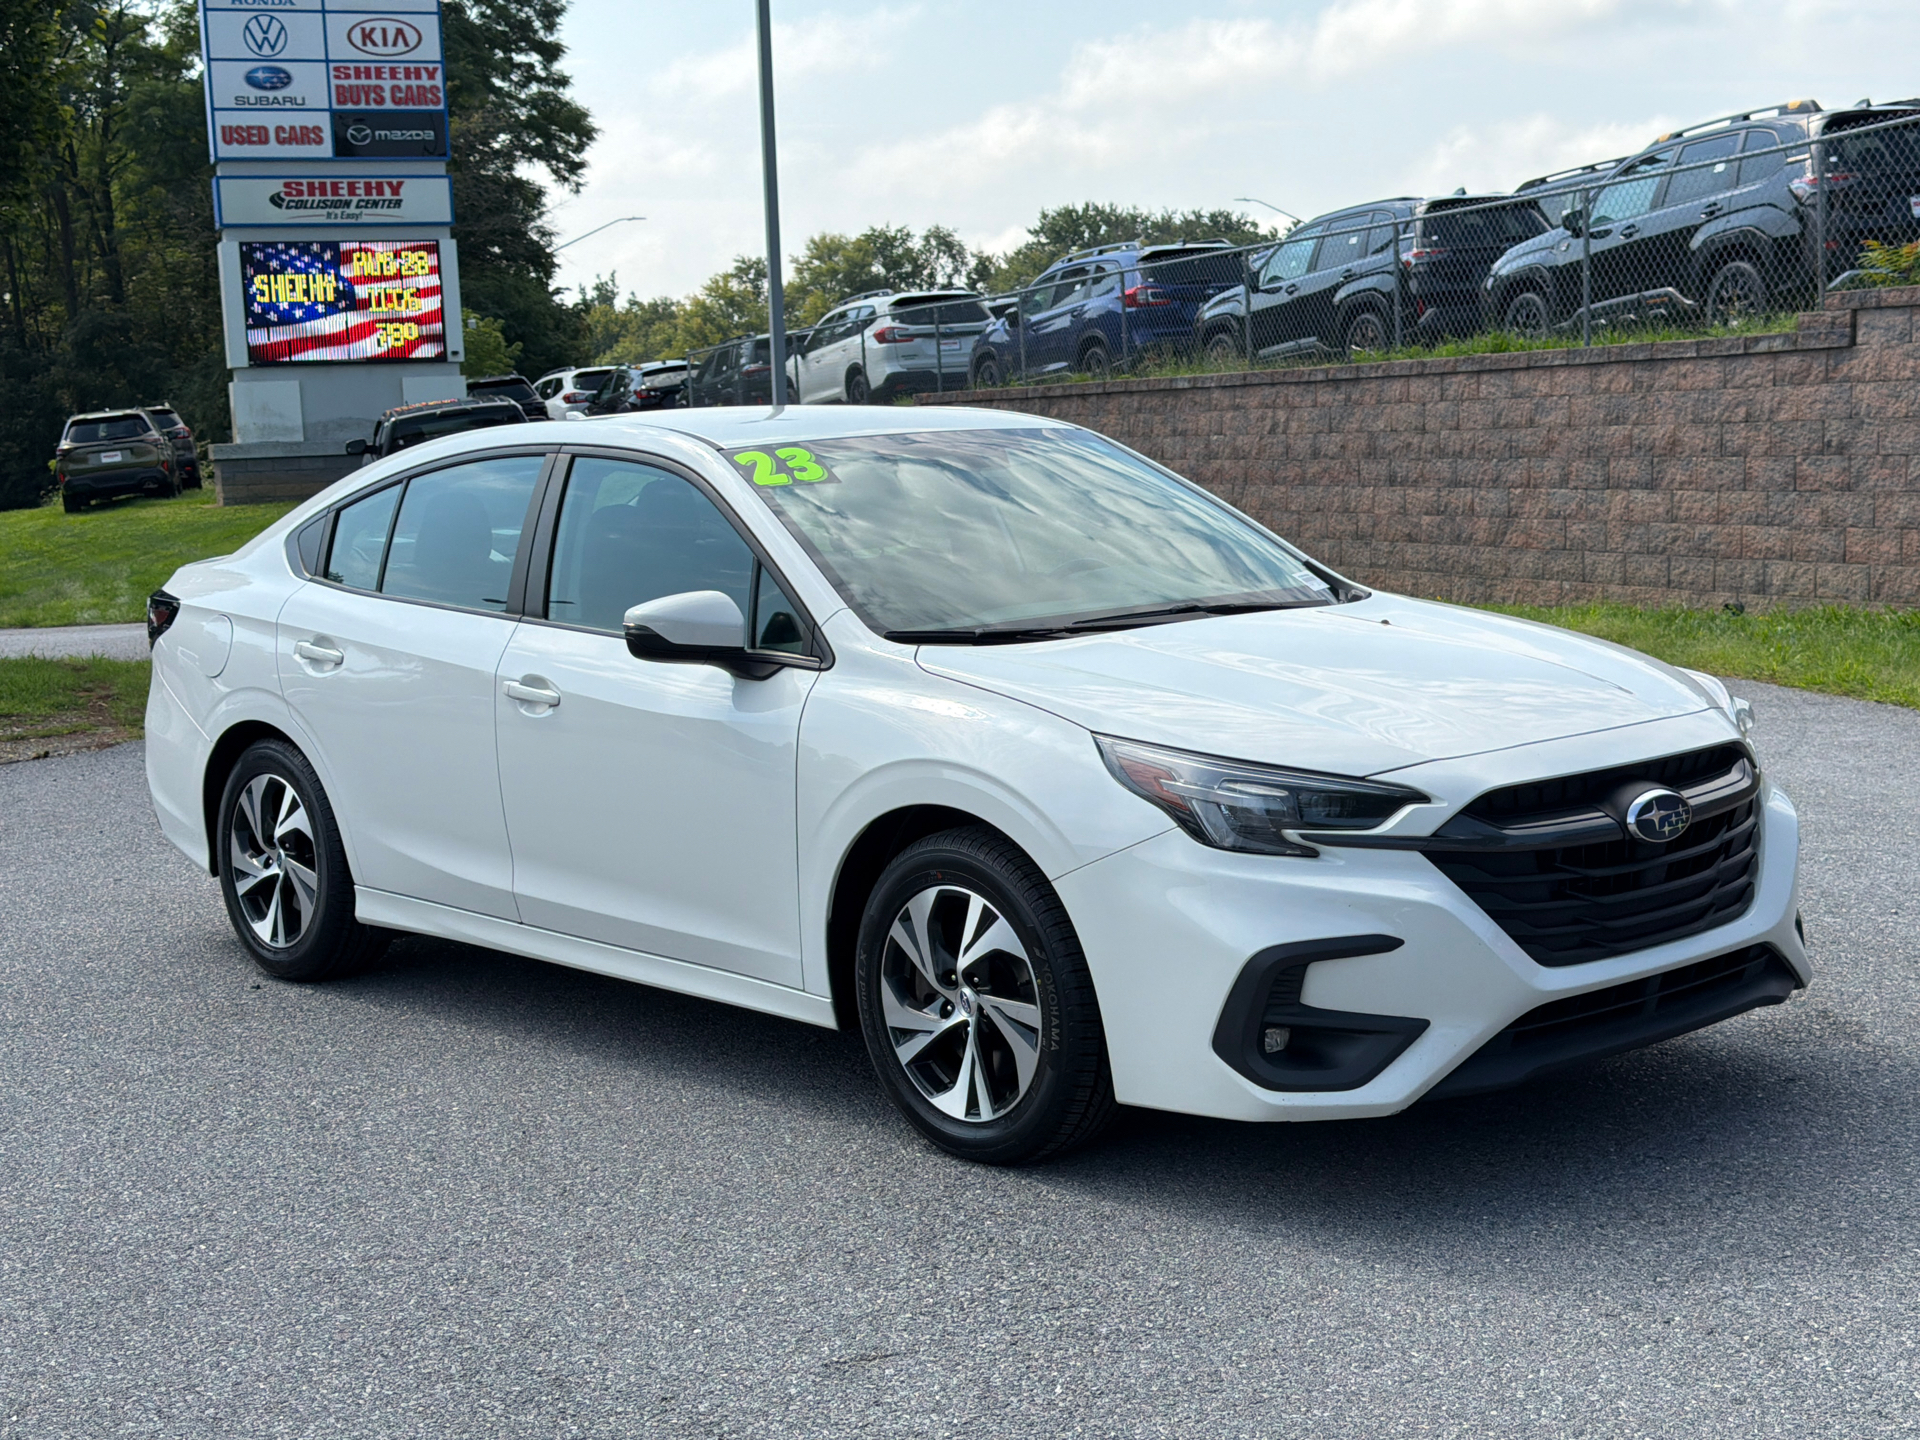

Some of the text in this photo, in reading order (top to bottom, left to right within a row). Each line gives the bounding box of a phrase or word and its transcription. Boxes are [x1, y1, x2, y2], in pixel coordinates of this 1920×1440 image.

[360, 27, 410, 48] KIA
[332, 65, 440, 81] SHEEHY
[234, 95, 306, 107] SUBARU
[334, 84, 442, 107] BUYS CARS
[220, 125, 324, 146] USED CARS
[282, 180, 405, 197] SHEEHY
[284, 198, 404, 210] COLLISION CENTER
[325, 210, 363, 221] It's Easy!
[254, 273, 337, 303] SHEEHY
[733, 447, 828, 486] 23
[1042, 963, 1060, 1051] YOKOHAMA
